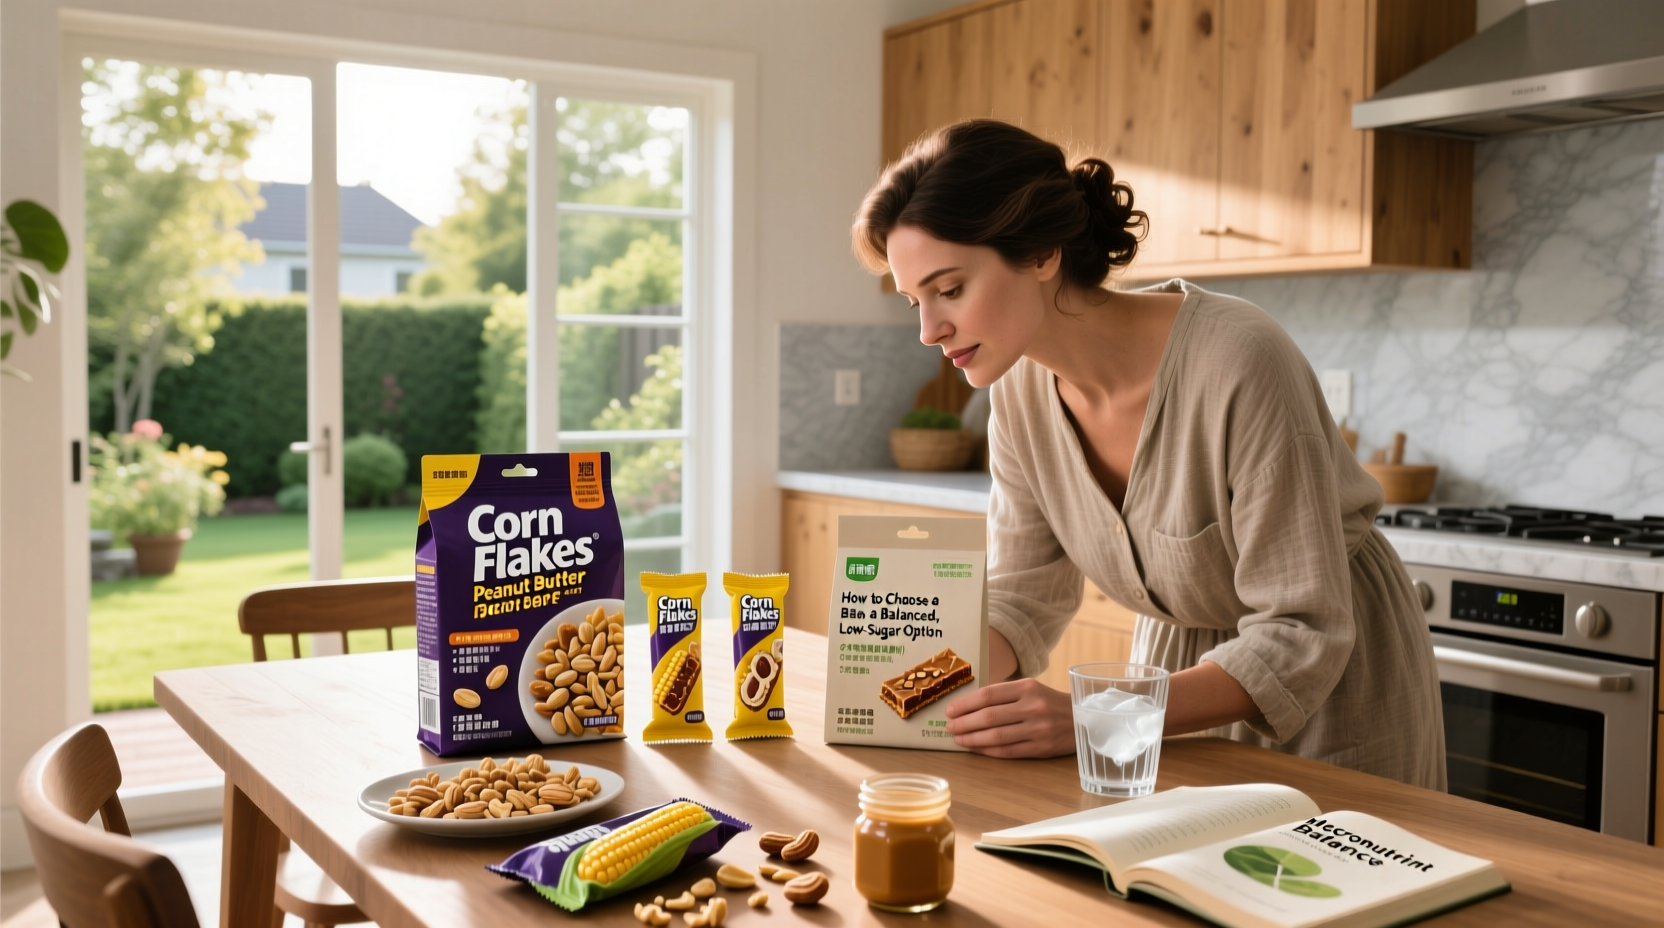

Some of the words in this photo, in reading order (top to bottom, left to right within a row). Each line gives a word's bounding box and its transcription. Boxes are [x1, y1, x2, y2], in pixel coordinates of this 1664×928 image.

[468, 504, 563, 543] Corn
[474, 578, 530, 602] Peanut
[534, 571, 586, 591] Butter
[658, 596, 692, 610] Corn
[741, 595, 773, 609] Corn
[841, 591, 867, 604] How
[871, 592, 883, 604] to
[885, 592, 929, 606] Choose
[931, 597, 940, 606] a
[869, 610, 877, 619] a
[880, 606, 940, 624] Balanced,
